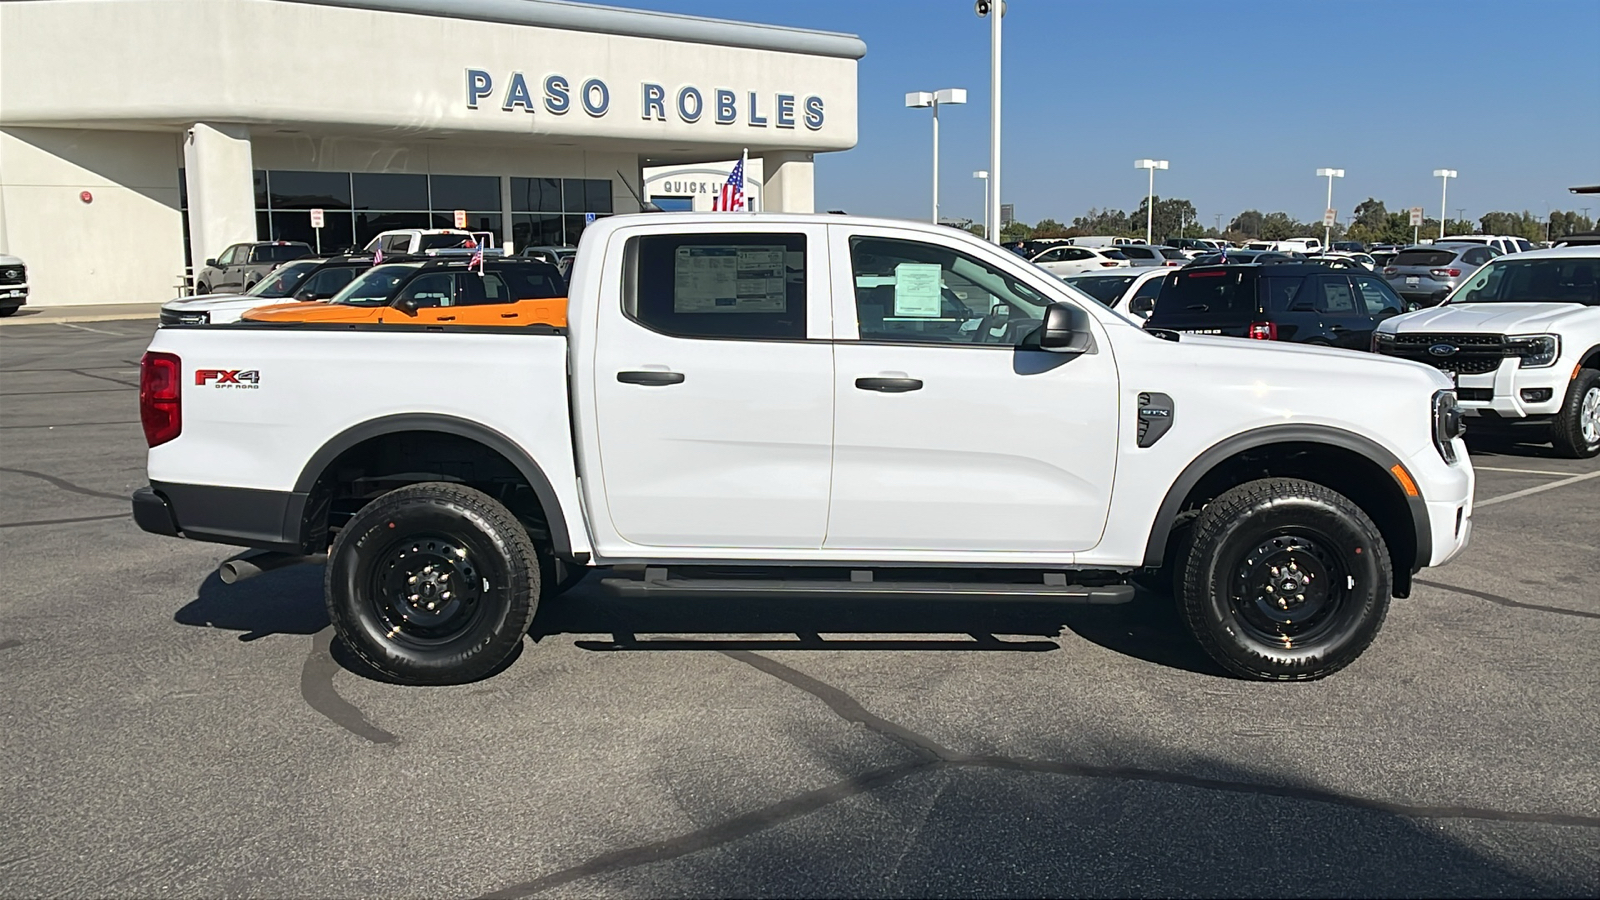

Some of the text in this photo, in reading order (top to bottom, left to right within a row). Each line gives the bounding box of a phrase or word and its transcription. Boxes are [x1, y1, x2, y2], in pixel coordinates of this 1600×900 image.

[466, 67, 826, 130] PASO ROBLES
[664, 180, 706, 194] QUICK
[195, 369, 260, 385] FX4
